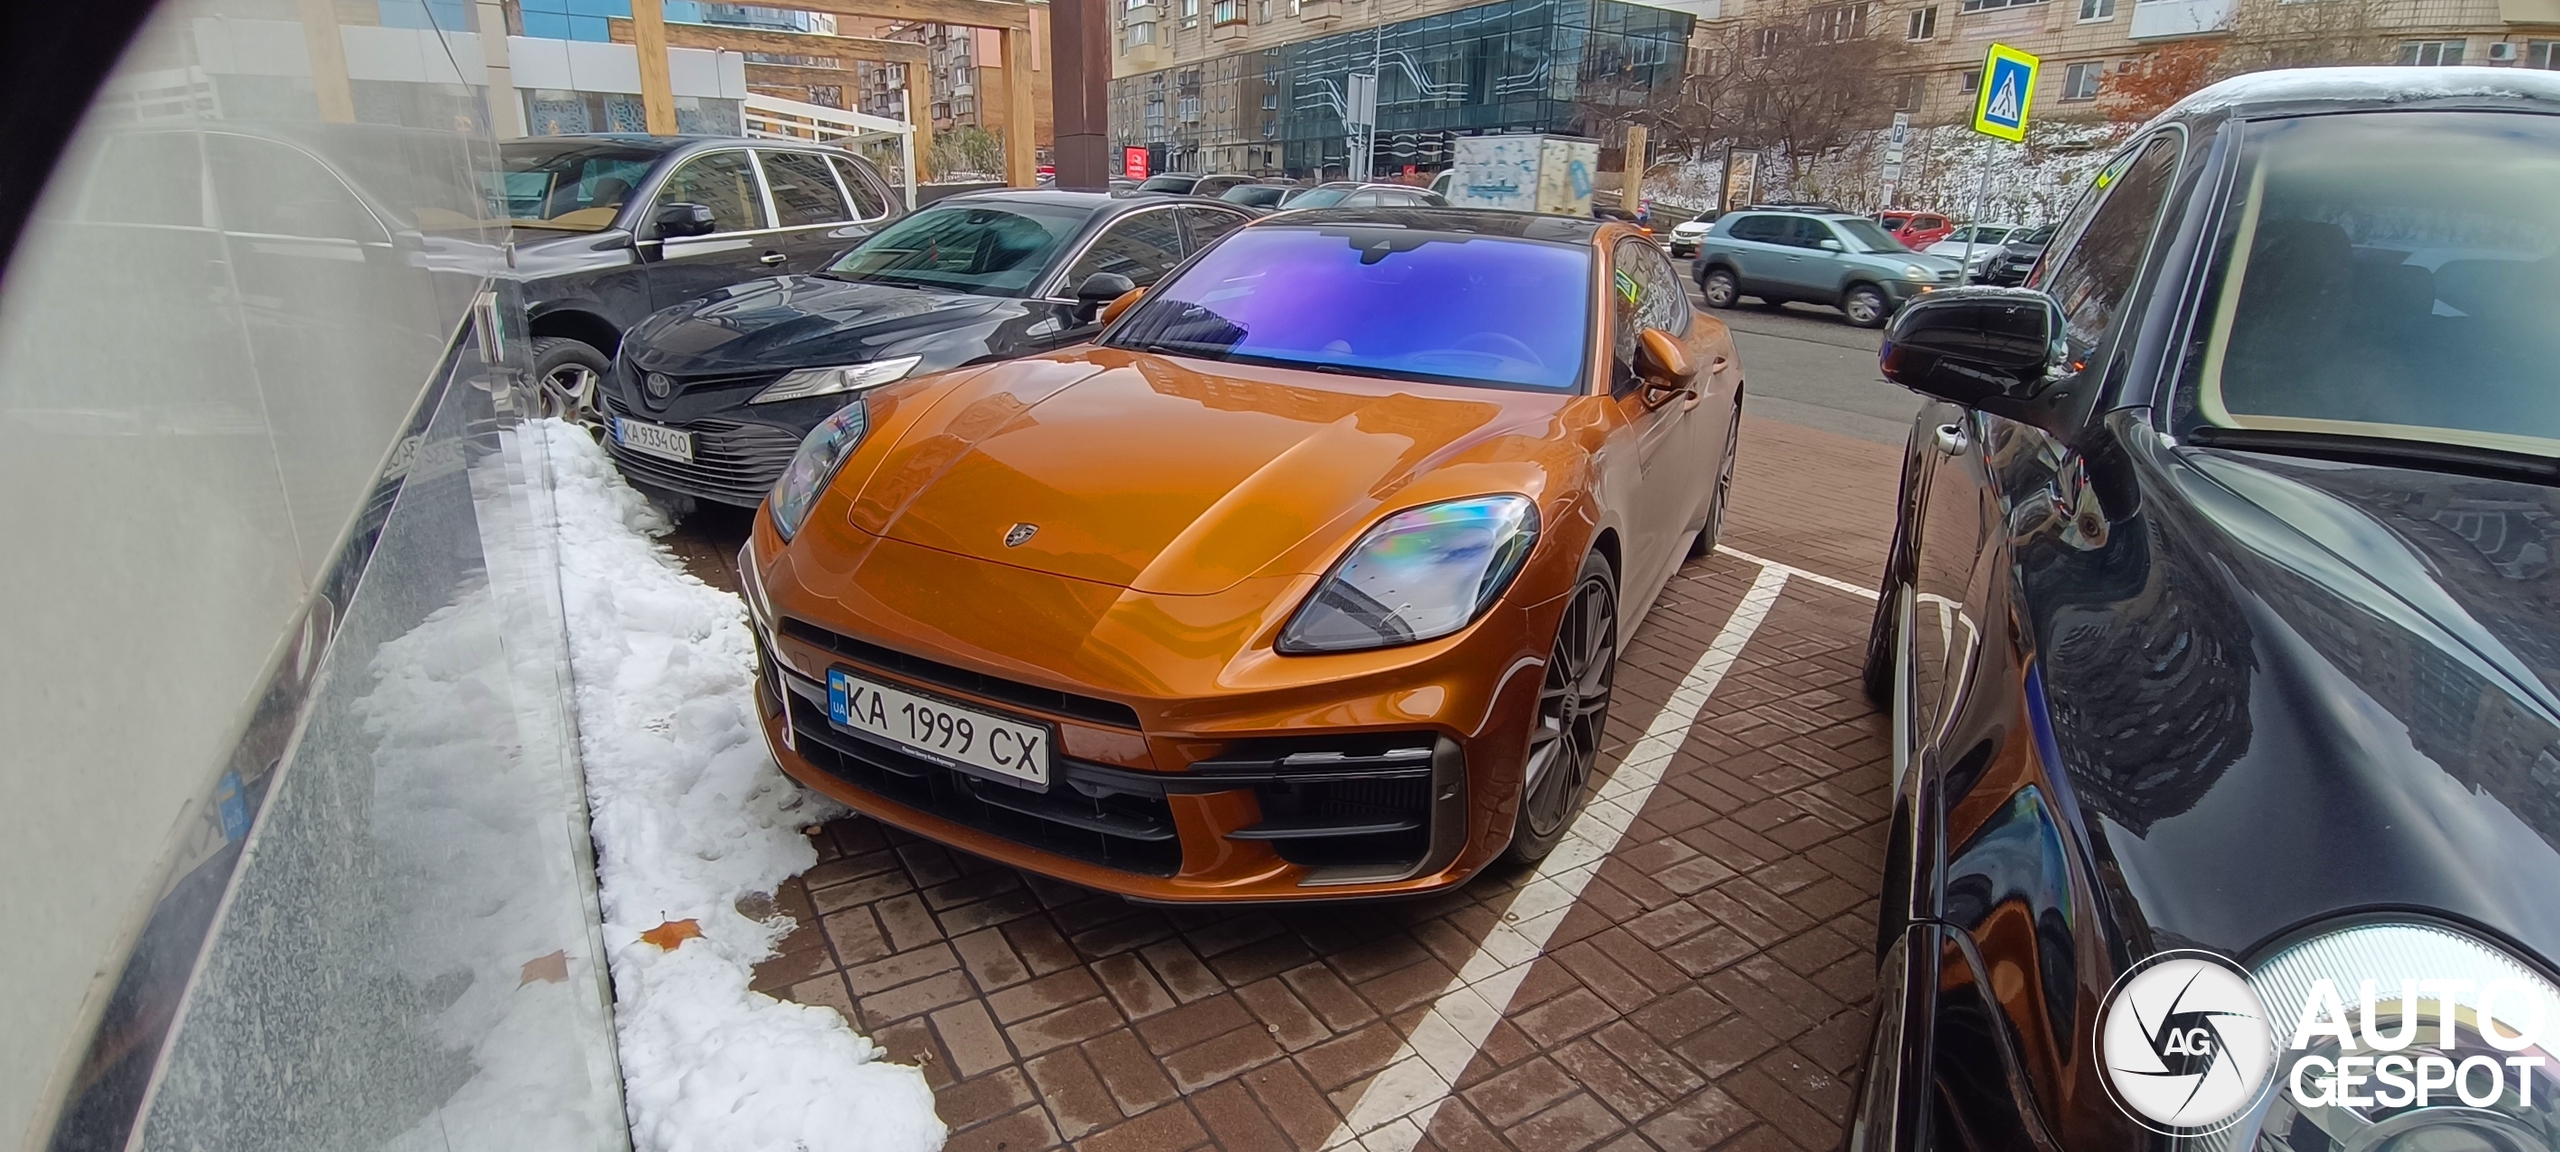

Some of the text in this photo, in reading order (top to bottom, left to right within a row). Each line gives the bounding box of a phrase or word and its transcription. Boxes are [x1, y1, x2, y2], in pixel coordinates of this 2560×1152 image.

[1894, 125, 1903, 142] P
[623, 422, 687, 453] KA 9334 CO
[832, 701, 846, 716] UA
[846, 681, 888, 730] KA
[902, 702, 975, 754] 1999
[989, 727, 1040, 775] CX
